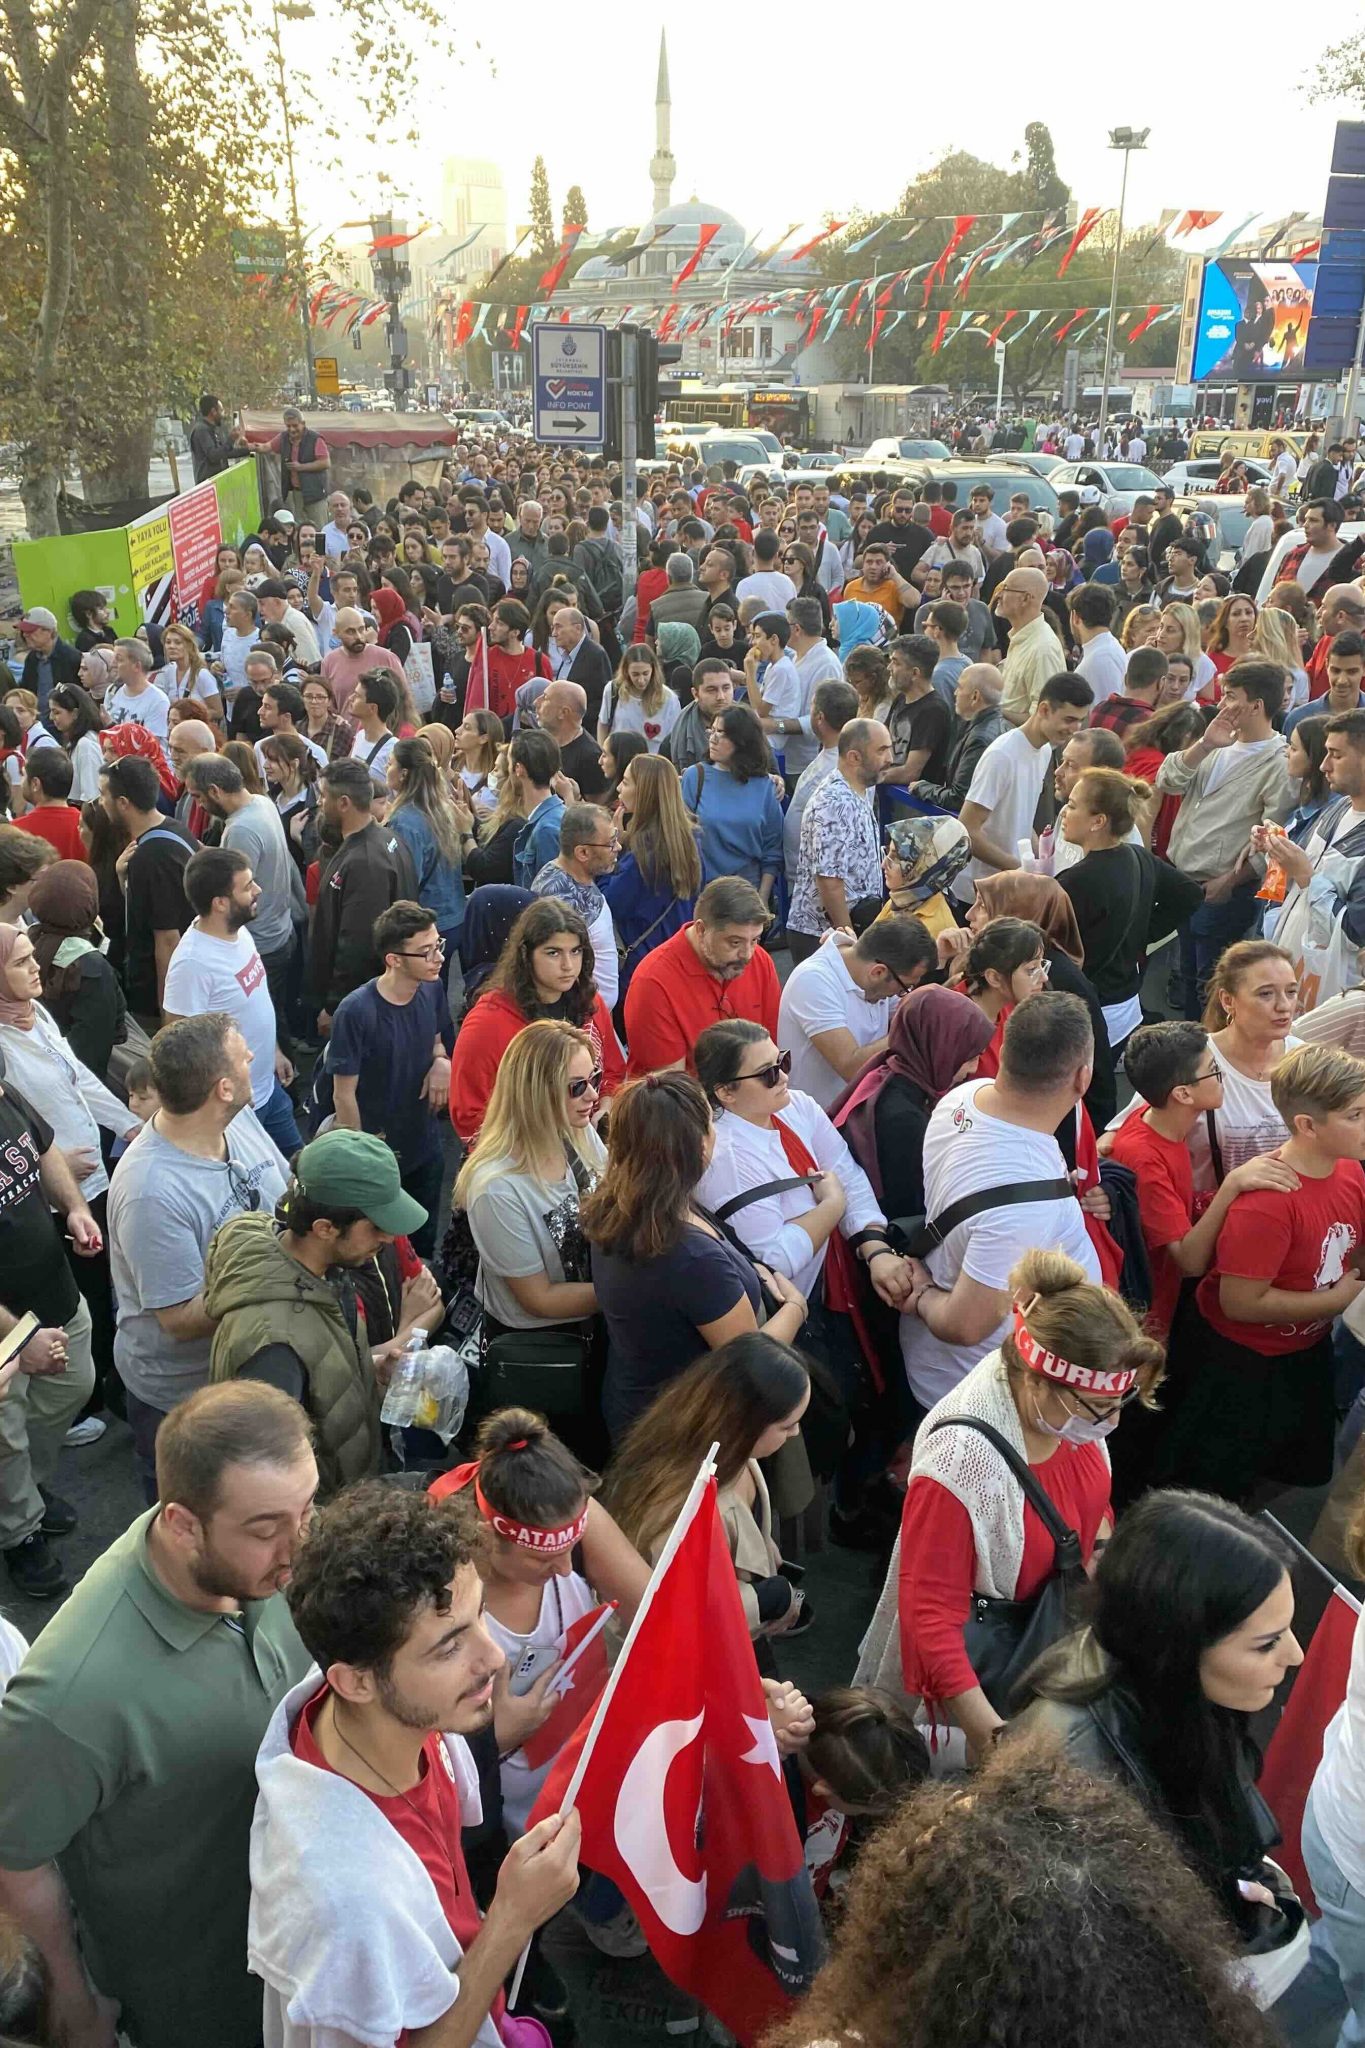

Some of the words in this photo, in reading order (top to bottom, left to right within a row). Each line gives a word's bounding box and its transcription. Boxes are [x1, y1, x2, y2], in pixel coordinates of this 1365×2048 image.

[547, 401, 566, 409] INFO
[567, 401, 592, 410] POINT
[136, 527, 152, 543] YAYA
[152, 521, 167, 536] YOLU
[517, 1526, 574, 1546] ATAM
